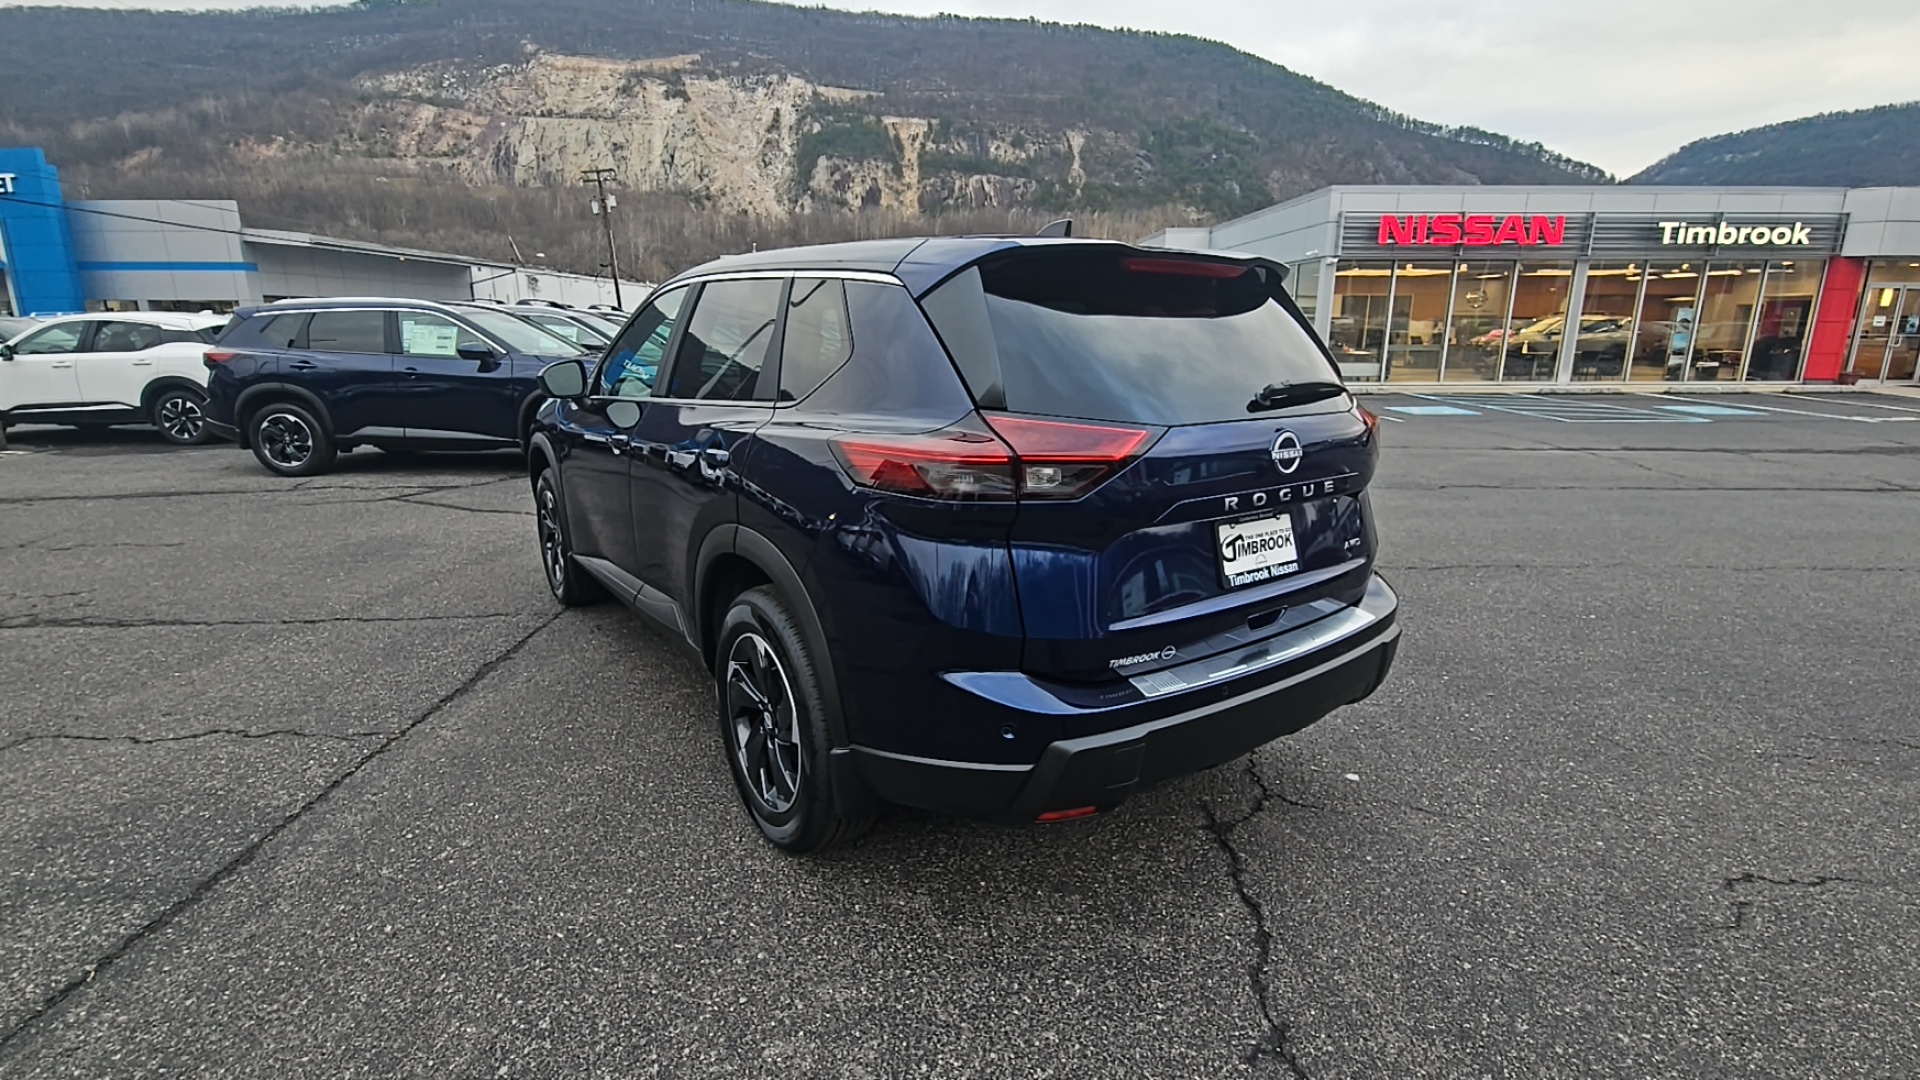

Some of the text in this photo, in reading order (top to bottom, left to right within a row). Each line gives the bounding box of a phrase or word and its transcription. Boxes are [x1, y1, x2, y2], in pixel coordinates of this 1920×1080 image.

[1377, 214, 1566, 245] NISSAN
[1658, 221, 1812, 246] Timbrook
[1271, 448, 1303, 460] NISSAN
[1224, 480, 1335, 511] ROGUE
[1222, 532, 1293, 563] TIMBROOK
[1344, 537, 1361, 550] AWD
[1228, 562, 1299, 587] Timbrook Nissan
[1108, 650, 1161, 668] TIMBROOK
